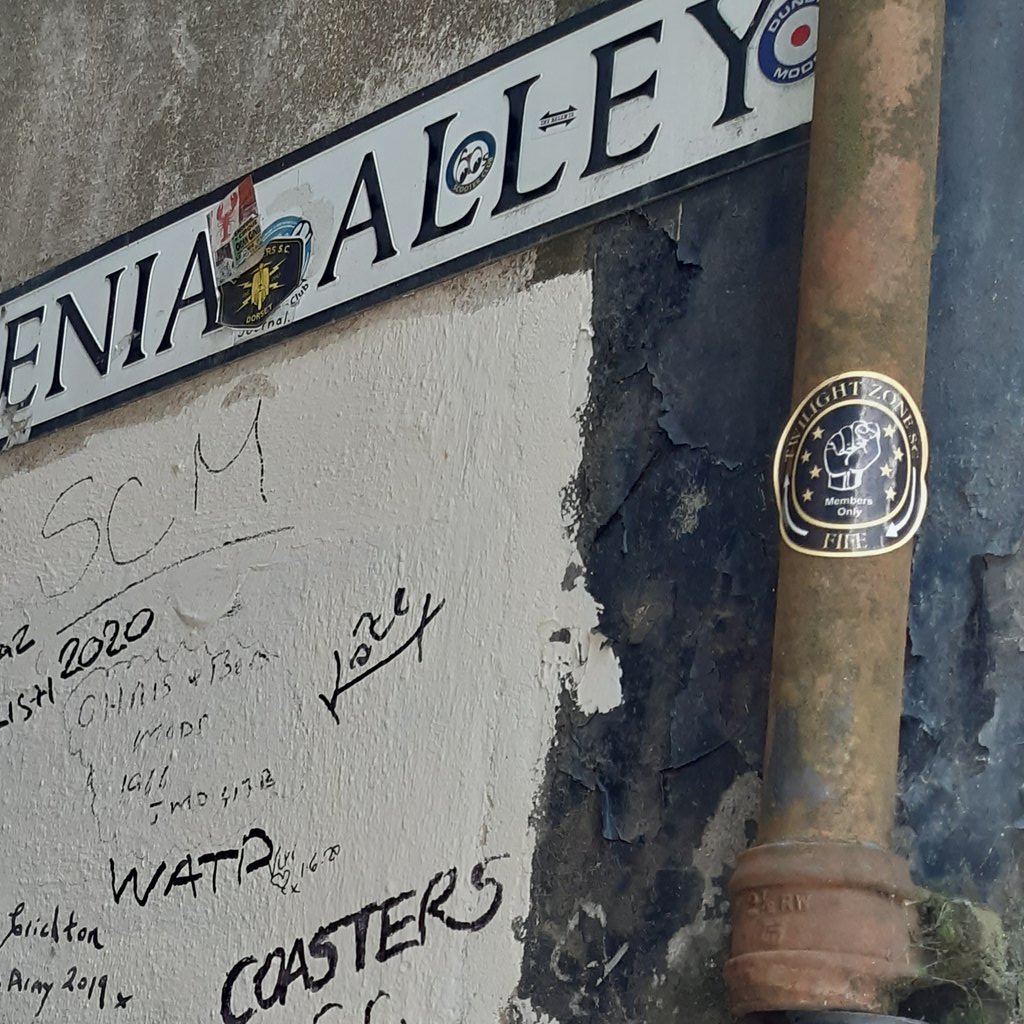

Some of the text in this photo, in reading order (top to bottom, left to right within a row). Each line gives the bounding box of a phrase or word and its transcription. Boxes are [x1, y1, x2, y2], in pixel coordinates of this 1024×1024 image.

[773, 60, 816, 80] MOD
[317, 0, 769, 288] ALLEY
[245, 303, 274, 324] DORSET
[784, 380, 863, 463] TWILIGHT
[824, 496, 874, 507] Members
[836, 507, 863, 518] Only
[823, 531, 869, 550] FIFE
[58, 607, 155, 680] 2020
[61, 966, 108, 1010] 2019
